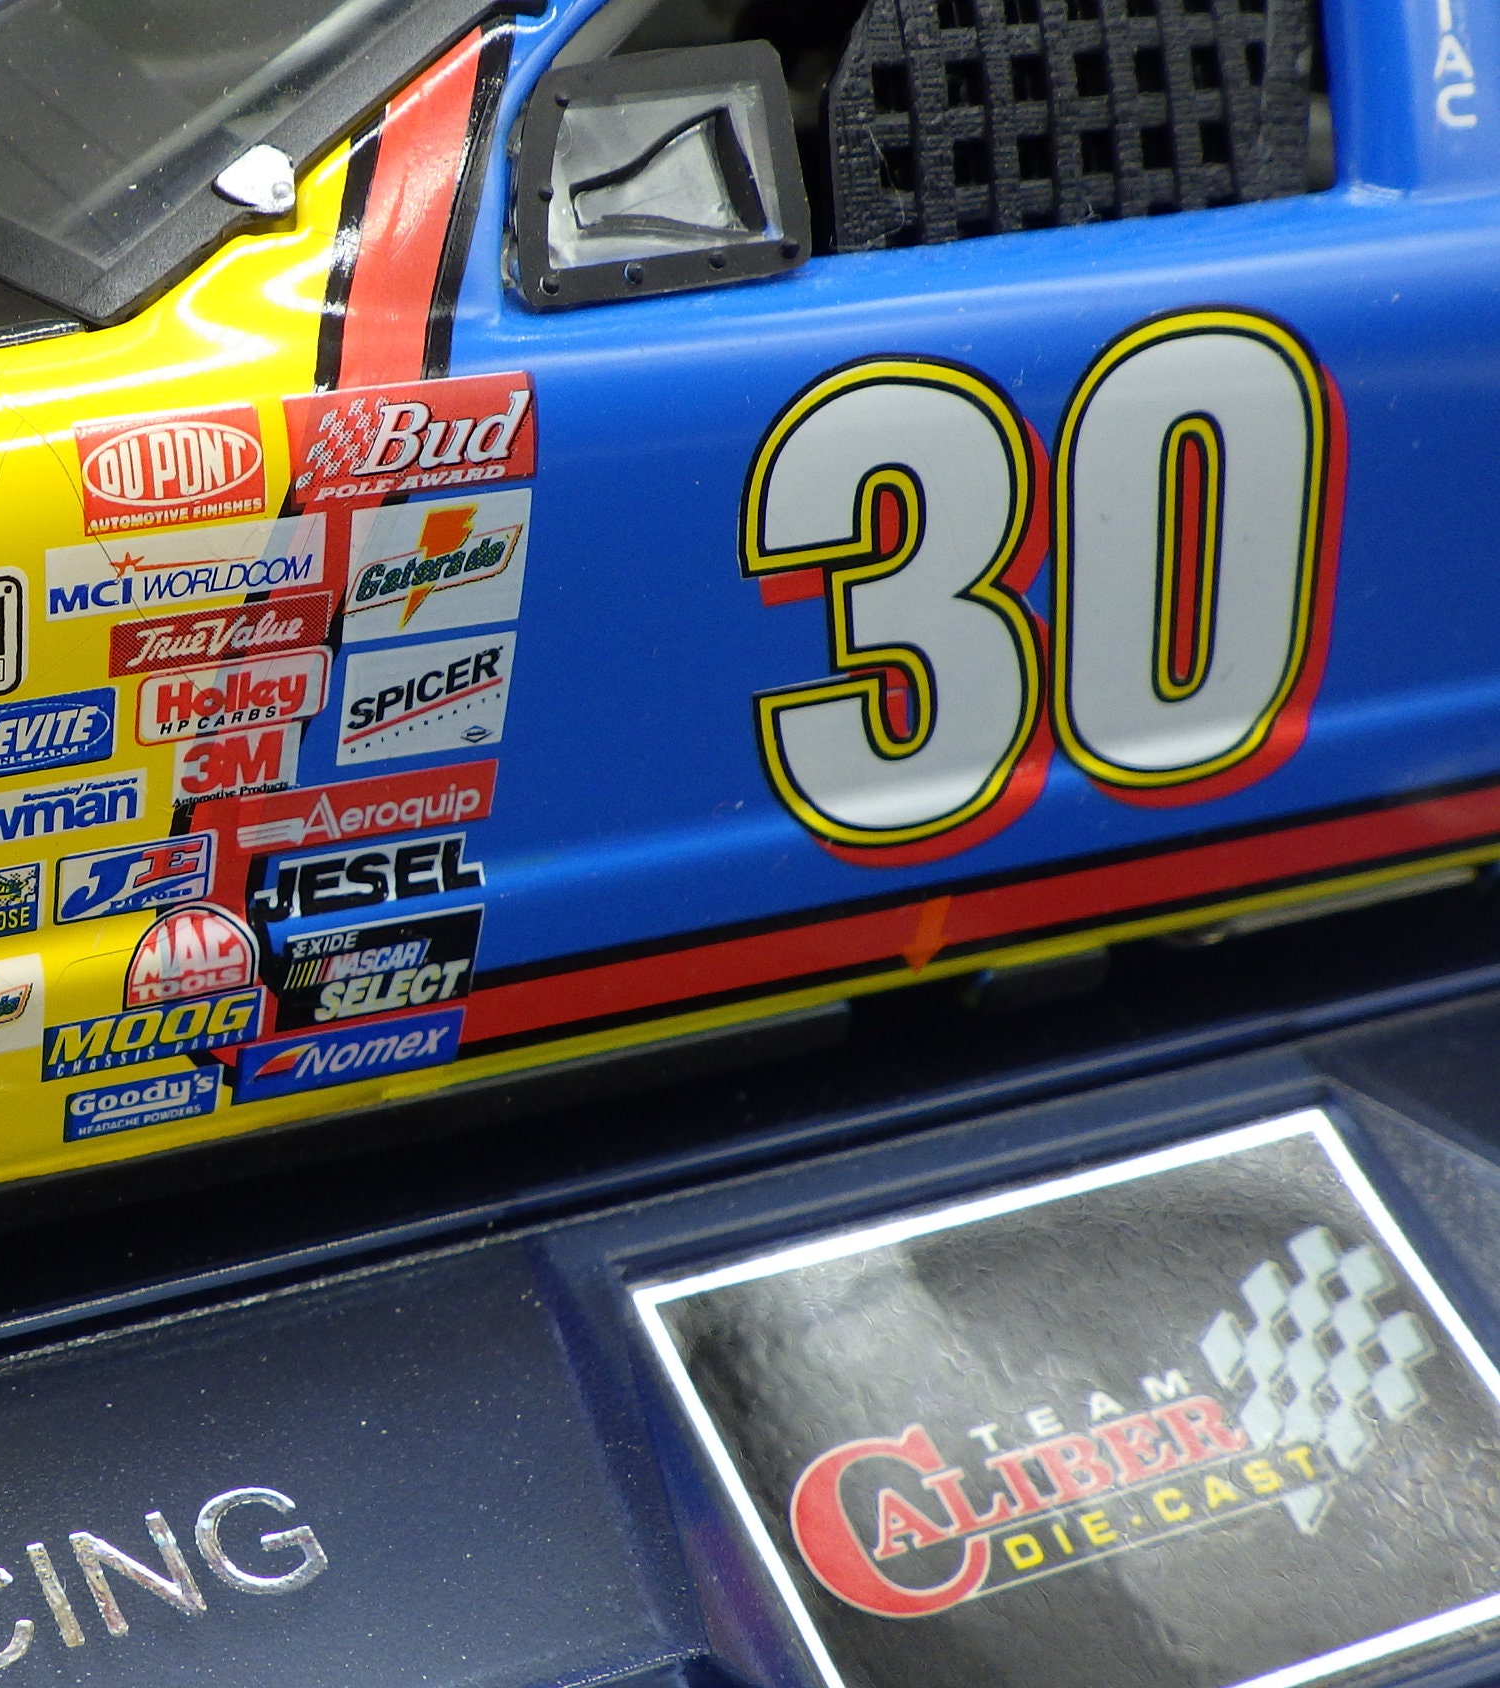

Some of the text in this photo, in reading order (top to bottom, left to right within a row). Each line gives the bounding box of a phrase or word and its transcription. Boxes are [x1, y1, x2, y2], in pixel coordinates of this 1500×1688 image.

[355, 390, 530, 476] Bud
[315, 465, 506, 502] POLE AWARD
[90, 497, 263, 533] AUTOMOTIVE FINISHES
[49, 553, 312, 615] MCI WORLDCOM
[354, 536, 506, 602] Gatorade
[740, 304, 1348, 868] 30
[156, 672, 306, 725] Holley
[347, 646, 503, 730] SPICER
[159, 705, 278, 736] HP CARBS
[181, 730, 285, 794] 3M
[171, 780, 289, 808] Automotive Products
[303, 784, 481, 843] Aeroquip
[252, 837, 486, 922] JESEL
[134, 916, 241, 985] MAC
[293, 930, 358, 958] EXIDE
[328, 938, 432, 981] NASCAR
[130, 967, 244, 1000] TOOLS
[315, 959, 470, 1022] SELECT
[48, 992, 258, 1066] MOOG
[57, 1029, 244, 1078] CHASSIS PARTS
[295, 1026, 450, 1079] Nomex
[69, 1073, 214, 1121] Goody's
[143, 1104, 202, 1124] POWDERS
[969, 1369, 1191, 1453] TEAM
[790, 1394, 1249, 1620] CALIBER
